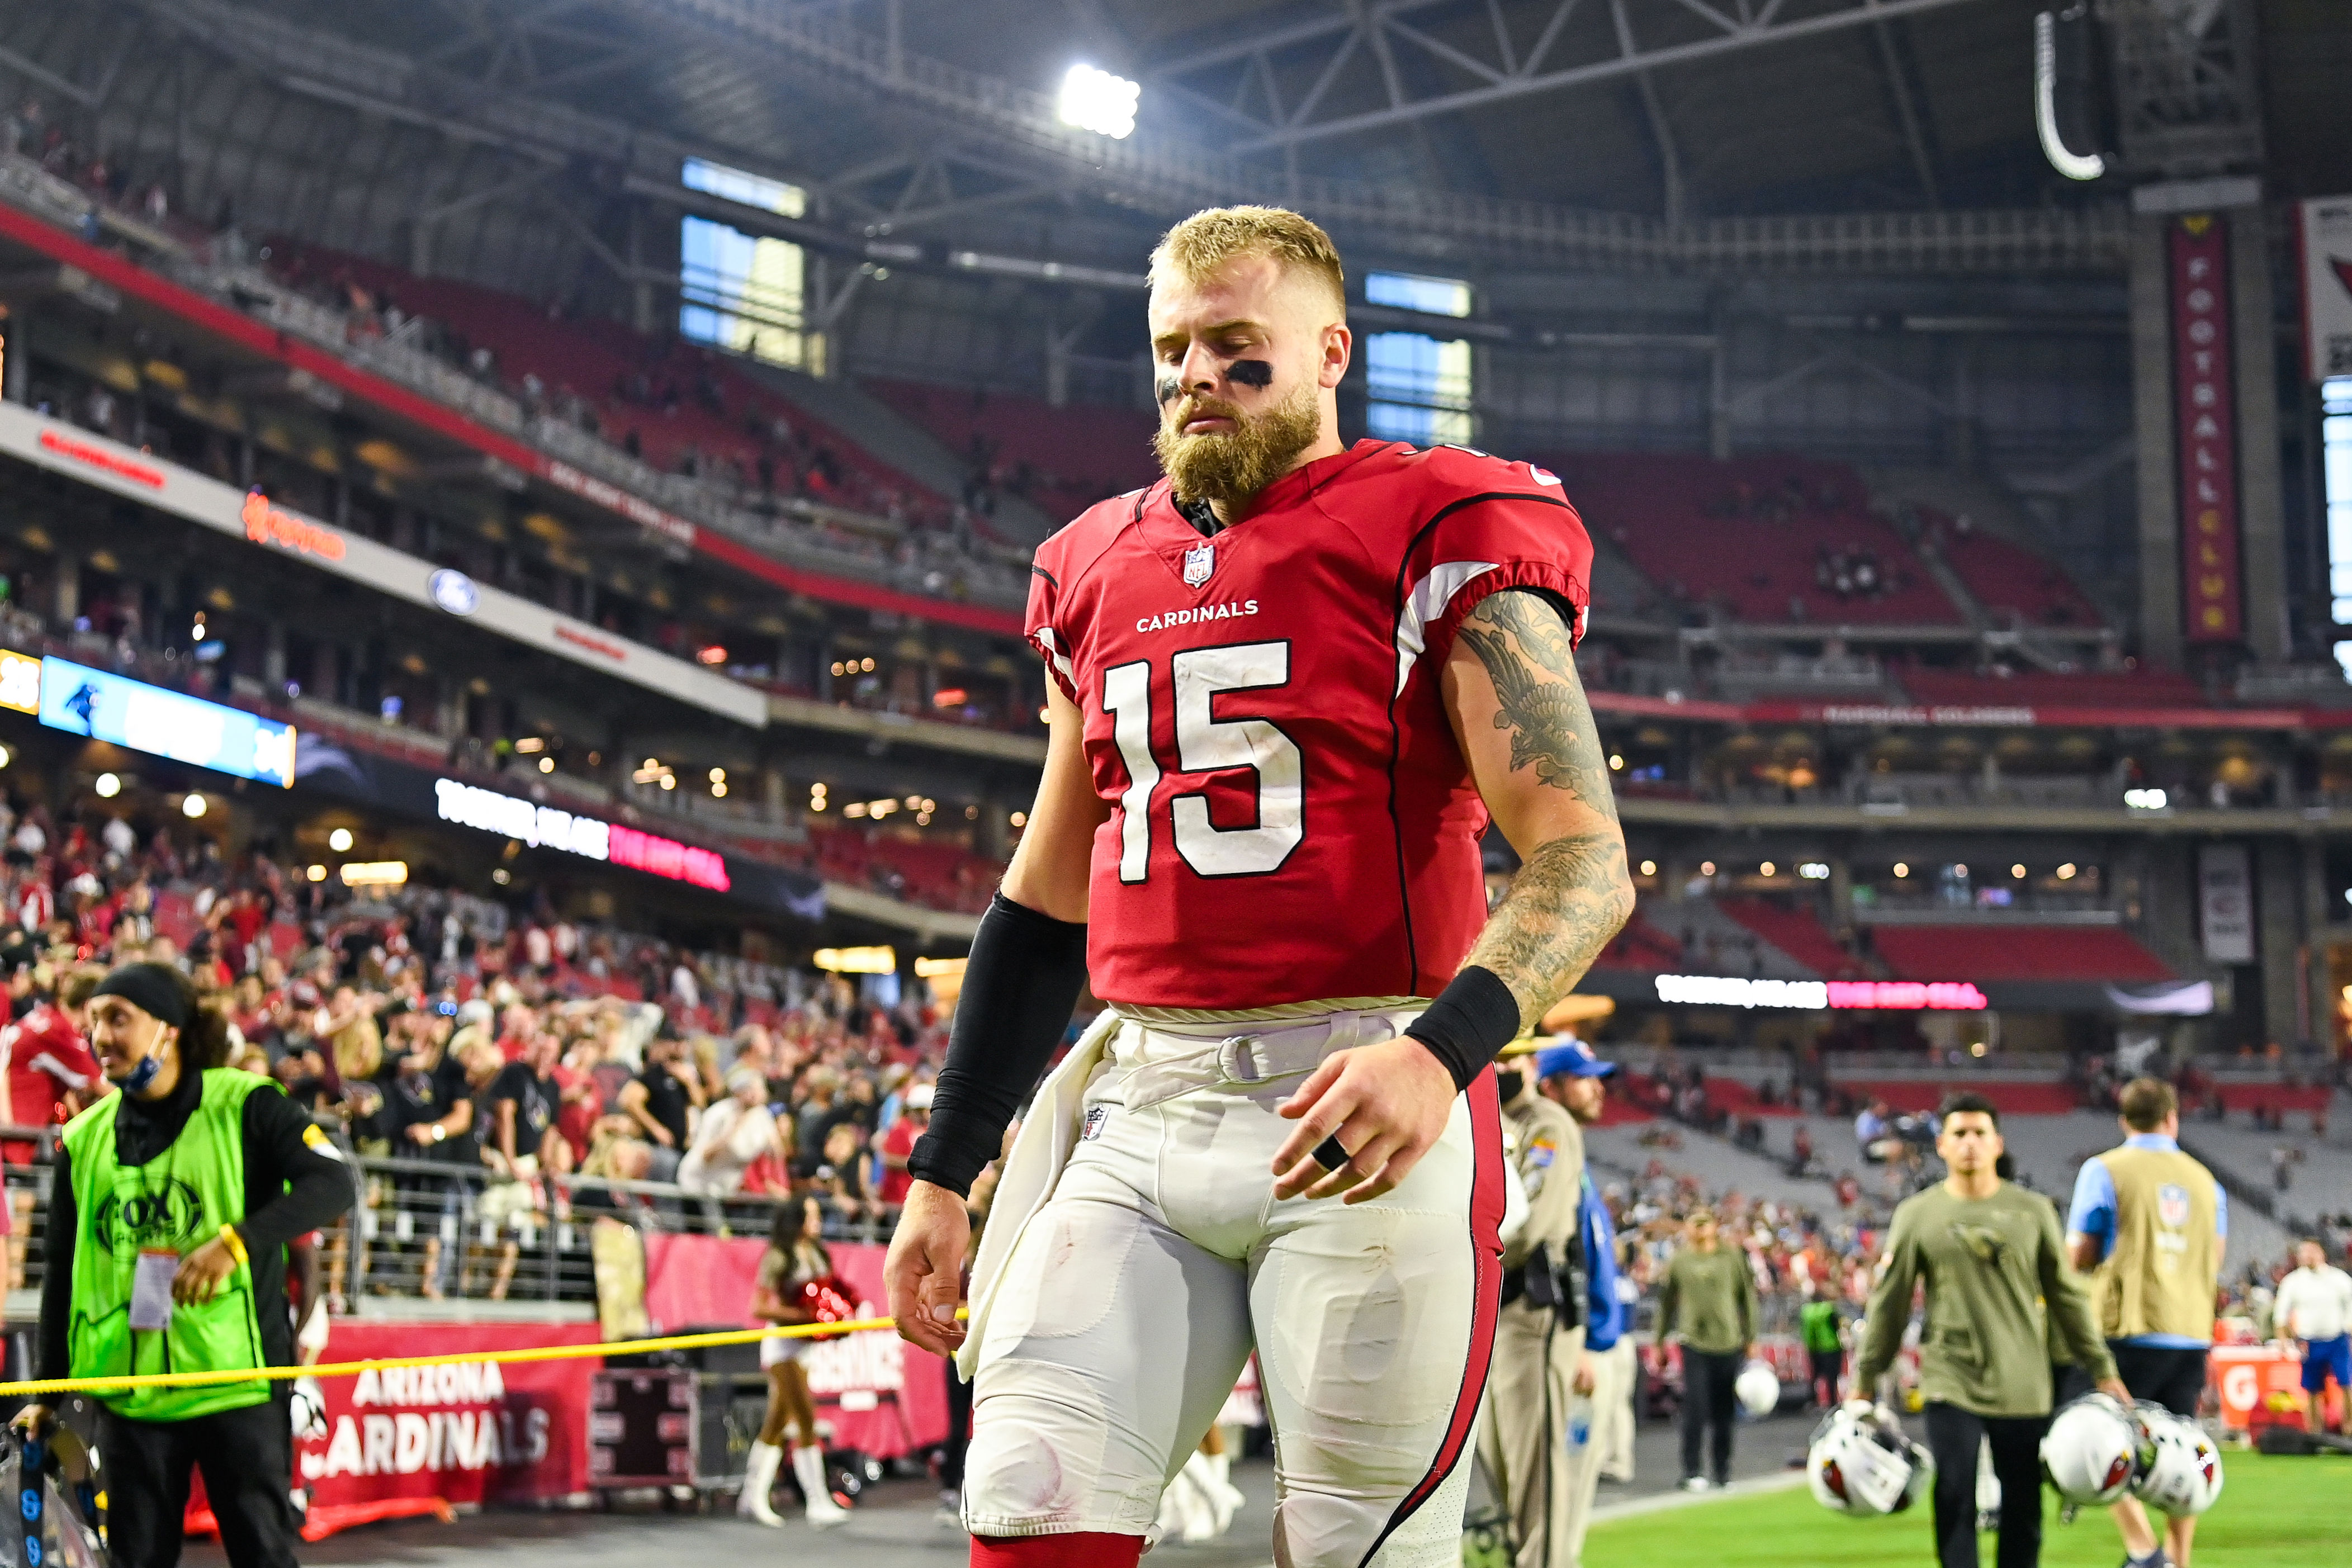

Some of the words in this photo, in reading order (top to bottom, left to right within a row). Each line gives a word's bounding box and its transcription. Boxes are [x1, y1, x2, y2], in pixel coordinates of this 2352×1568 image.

[1189, 562, 1207, 578] NFL
[1136, 600, 1258, 633] CARDINALS
[1102, 638, 1306, 885] 15
[351, 1359, 505, 1407] ARIZONA
[2223, 1364, 2259, 1412] G
